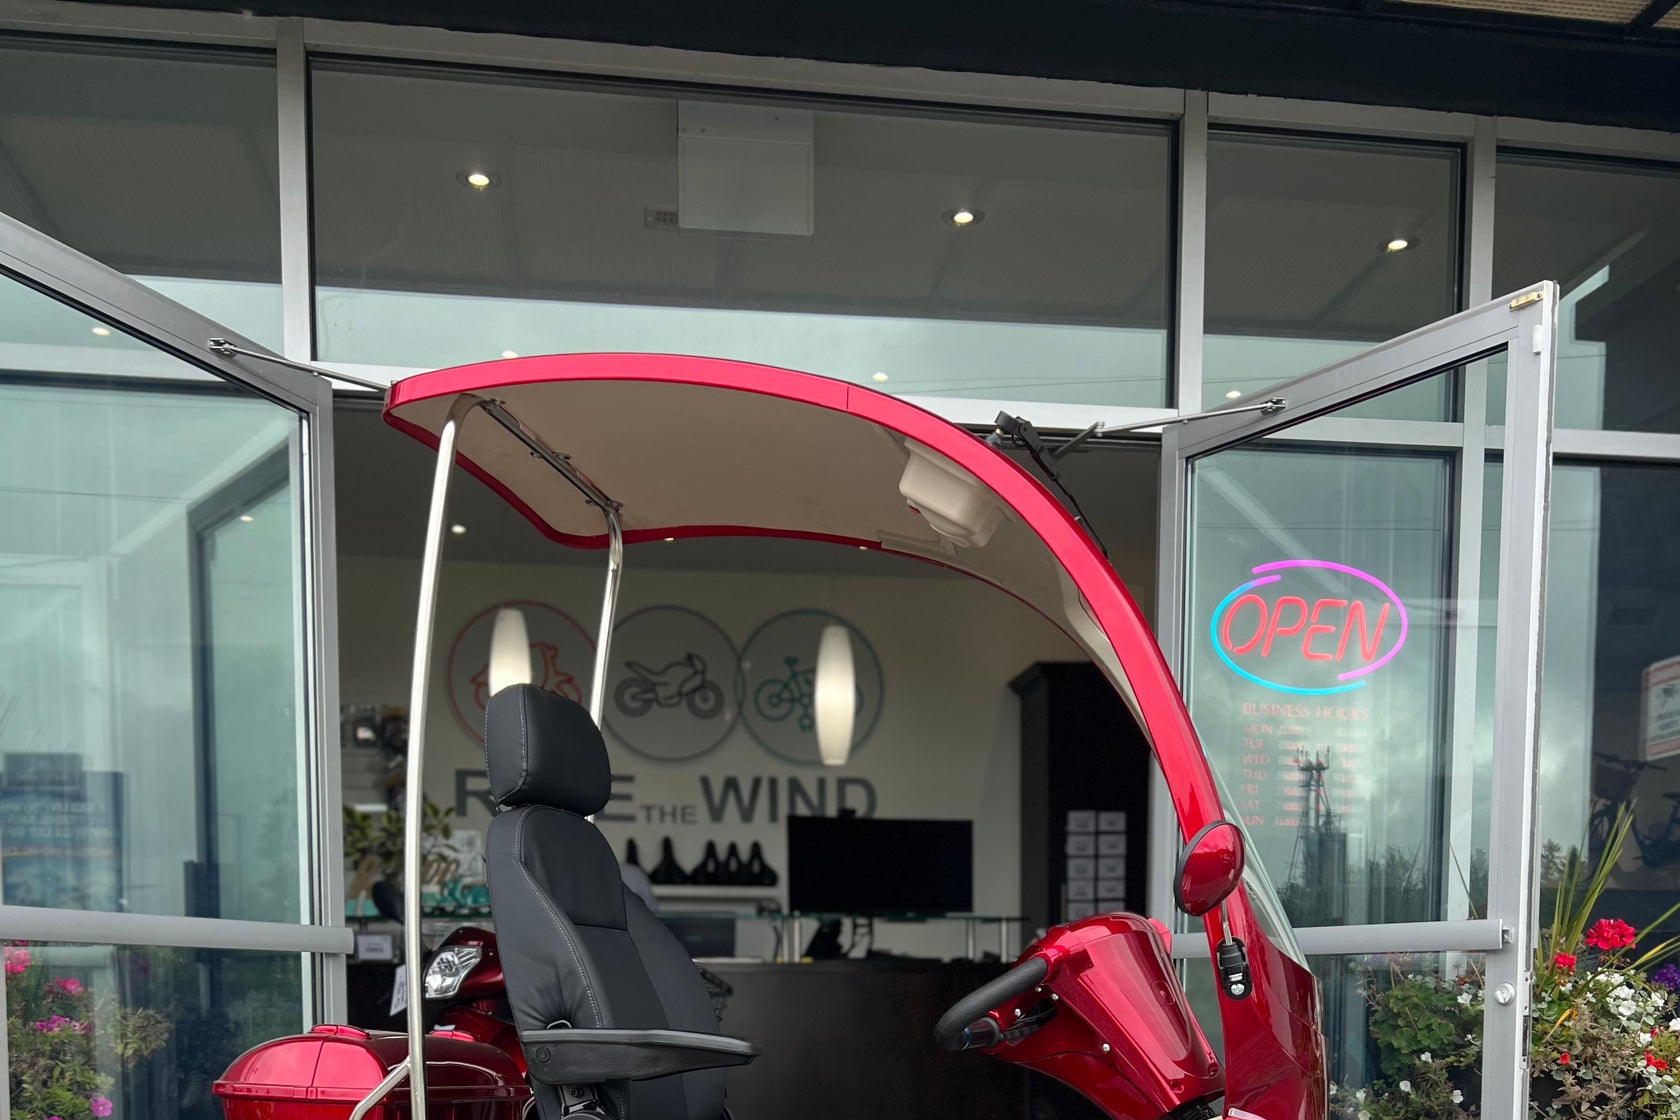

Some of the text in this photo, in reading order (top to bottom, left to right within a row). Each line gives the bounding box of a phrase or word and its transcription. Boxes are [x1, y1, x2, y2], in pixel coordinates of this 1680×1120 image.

[1221, 593, 1390, 662] OPEN
[1243, 702, 1369, 721] BUSINESS HOURS
[1243, 723, 1273, 735] MON
[1242, 754, 1271, 766] WED
[1241, 769, 1268, 780] THU
[1240, 784, 1259, 795] FRI
[455, 769, 878, 825] RE THE WIND
[1240, 800, 1262, 811] SAT
